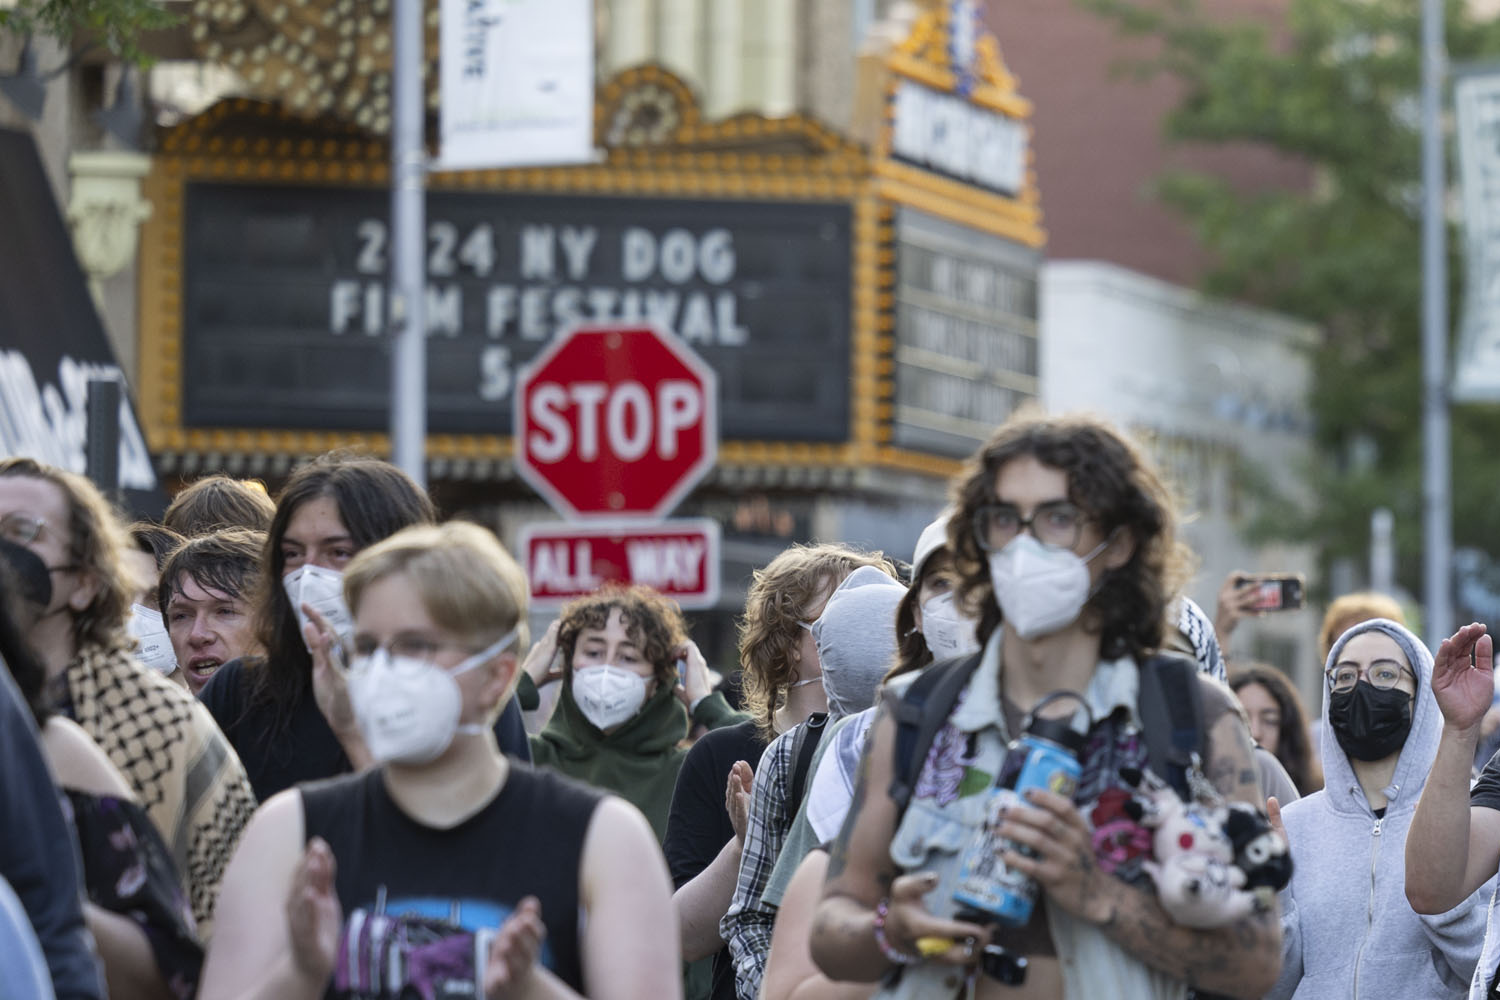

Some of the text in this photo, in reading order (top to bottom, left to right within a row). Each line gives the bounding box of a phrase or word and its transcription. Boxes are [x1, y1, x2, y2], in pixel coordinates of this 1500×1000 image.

[357, 220, 737, 284] 224 NY DOG
[330, 280, 463, 338] FIM
[529, 382, 702, 462] STOP
[532, 538, 704, 592] ALL WAY
